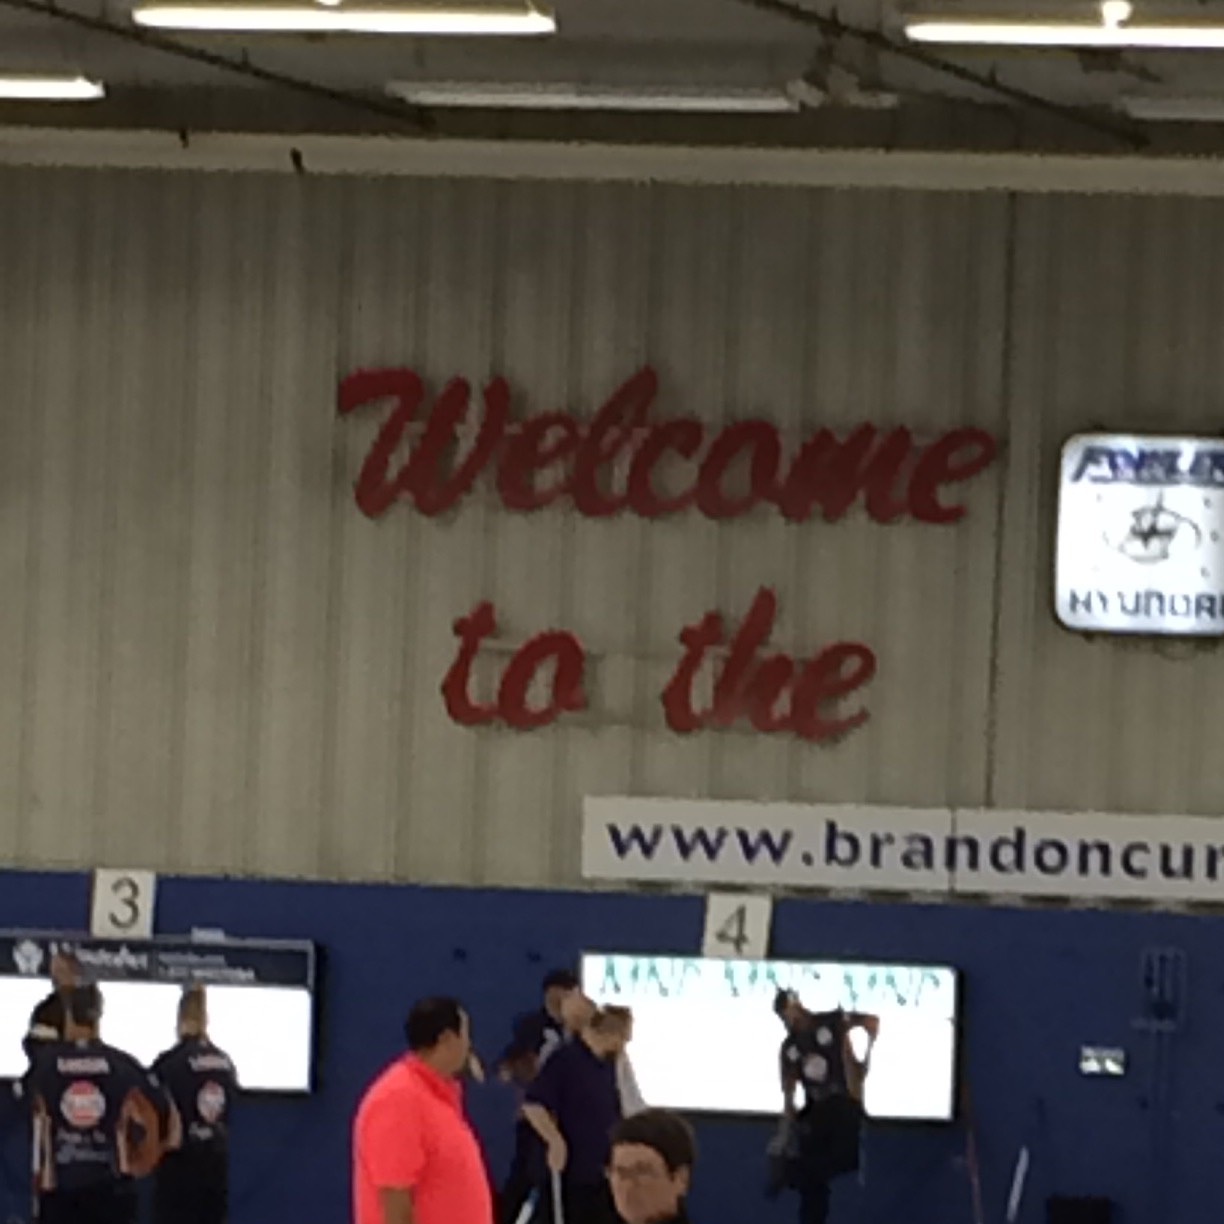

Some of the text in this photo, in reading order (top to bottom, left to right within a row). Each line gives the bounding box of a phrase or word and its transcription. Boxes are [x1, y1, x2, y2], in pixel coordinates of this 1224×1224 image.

[338, 364, 997, 524] Welcome
[441, 585, 878, 742] to the
[108, 877, 141, 930] 3
[714, 904, 750, 954] 4
